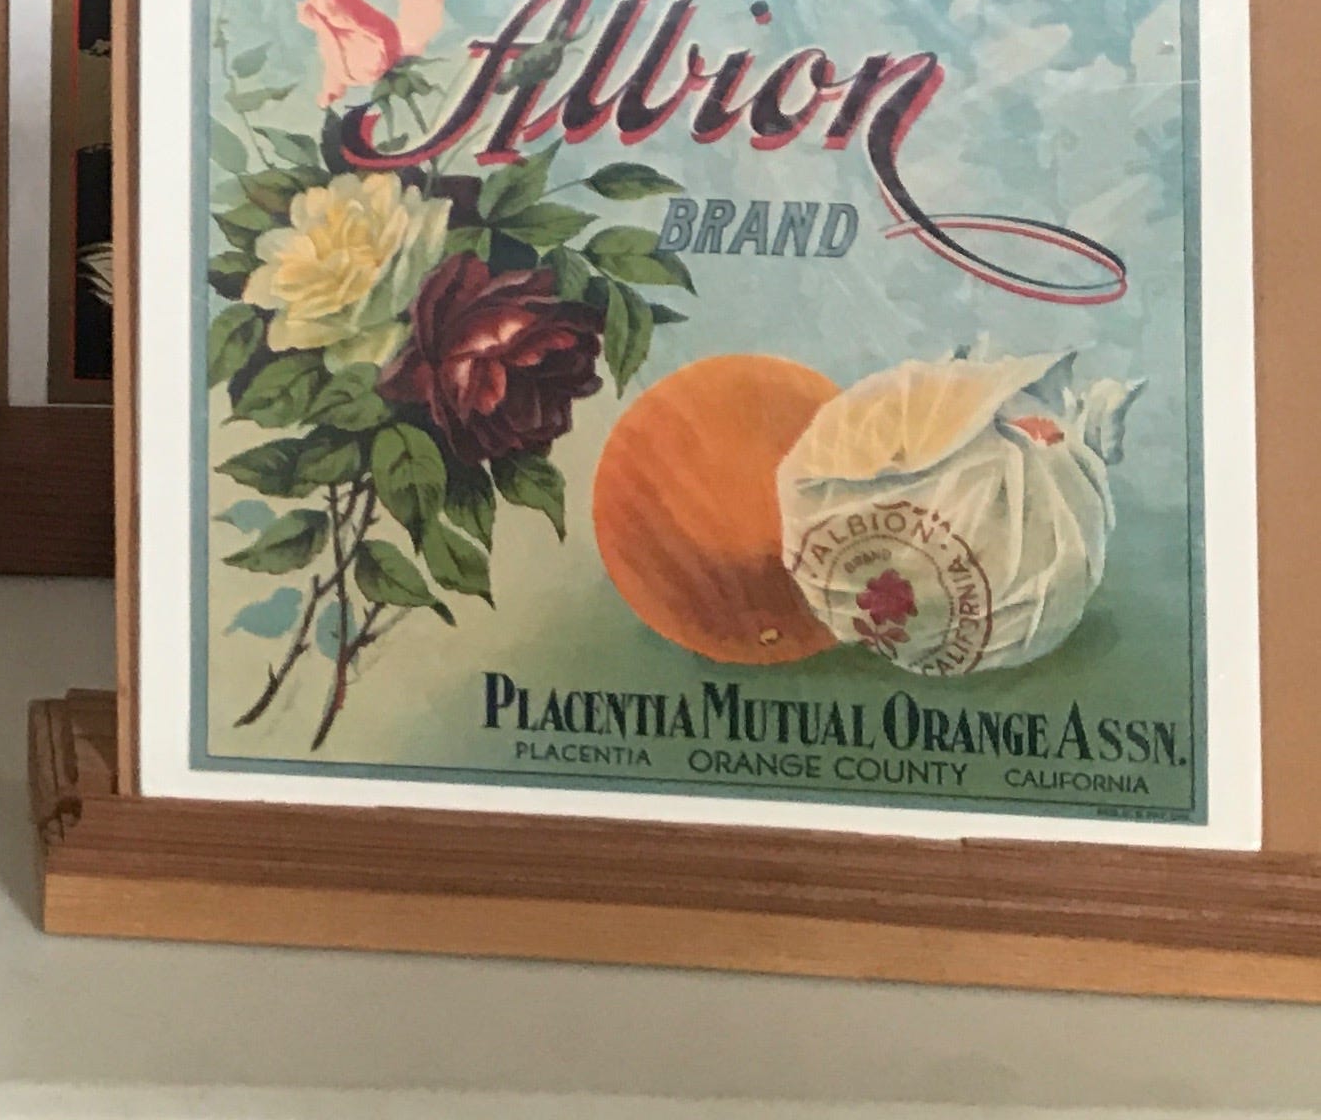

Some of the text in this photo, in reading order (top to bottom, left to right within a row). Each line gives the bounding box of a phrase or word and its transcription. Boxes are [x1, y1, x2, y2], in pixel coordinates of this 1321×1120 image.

[658, 197, 860, 259] BRAND
[482, 671, 1189, 768] PLACENTIA MUTUAL ORANGE ASSN.
[517, 742, 1149, 795] PLACENTIA ORANGE COUNTY CALIFORNIA
